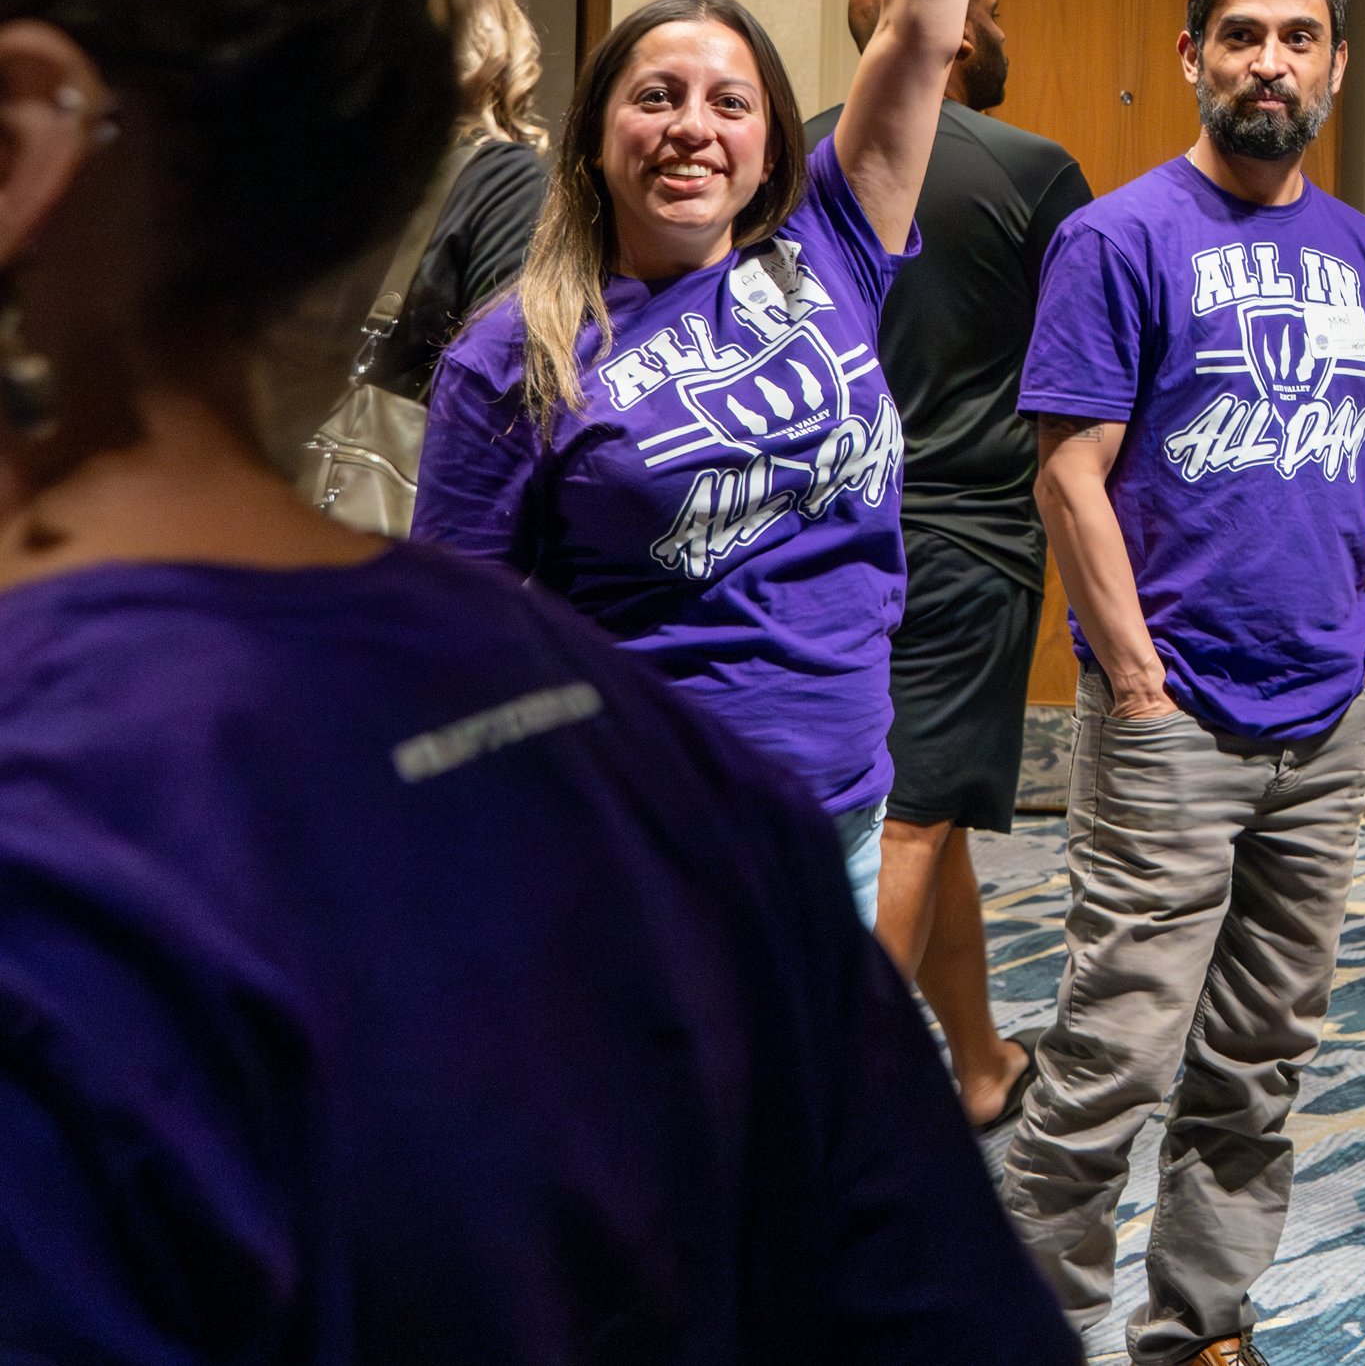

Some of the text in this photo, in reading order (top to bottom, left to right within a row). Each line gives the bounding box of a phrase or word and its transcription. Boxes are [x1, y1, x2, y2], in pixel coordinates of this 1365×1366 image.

[1192, 242, 1362, 317] ALL IN
[598, 312, 752, 412] ALL
[788, 424, 822, 441] RANCH
[795, 409, 831, 429] VALLEY
[1164, 393, 1279, 482] ALL
[651, 454, 796, 580] ALL
